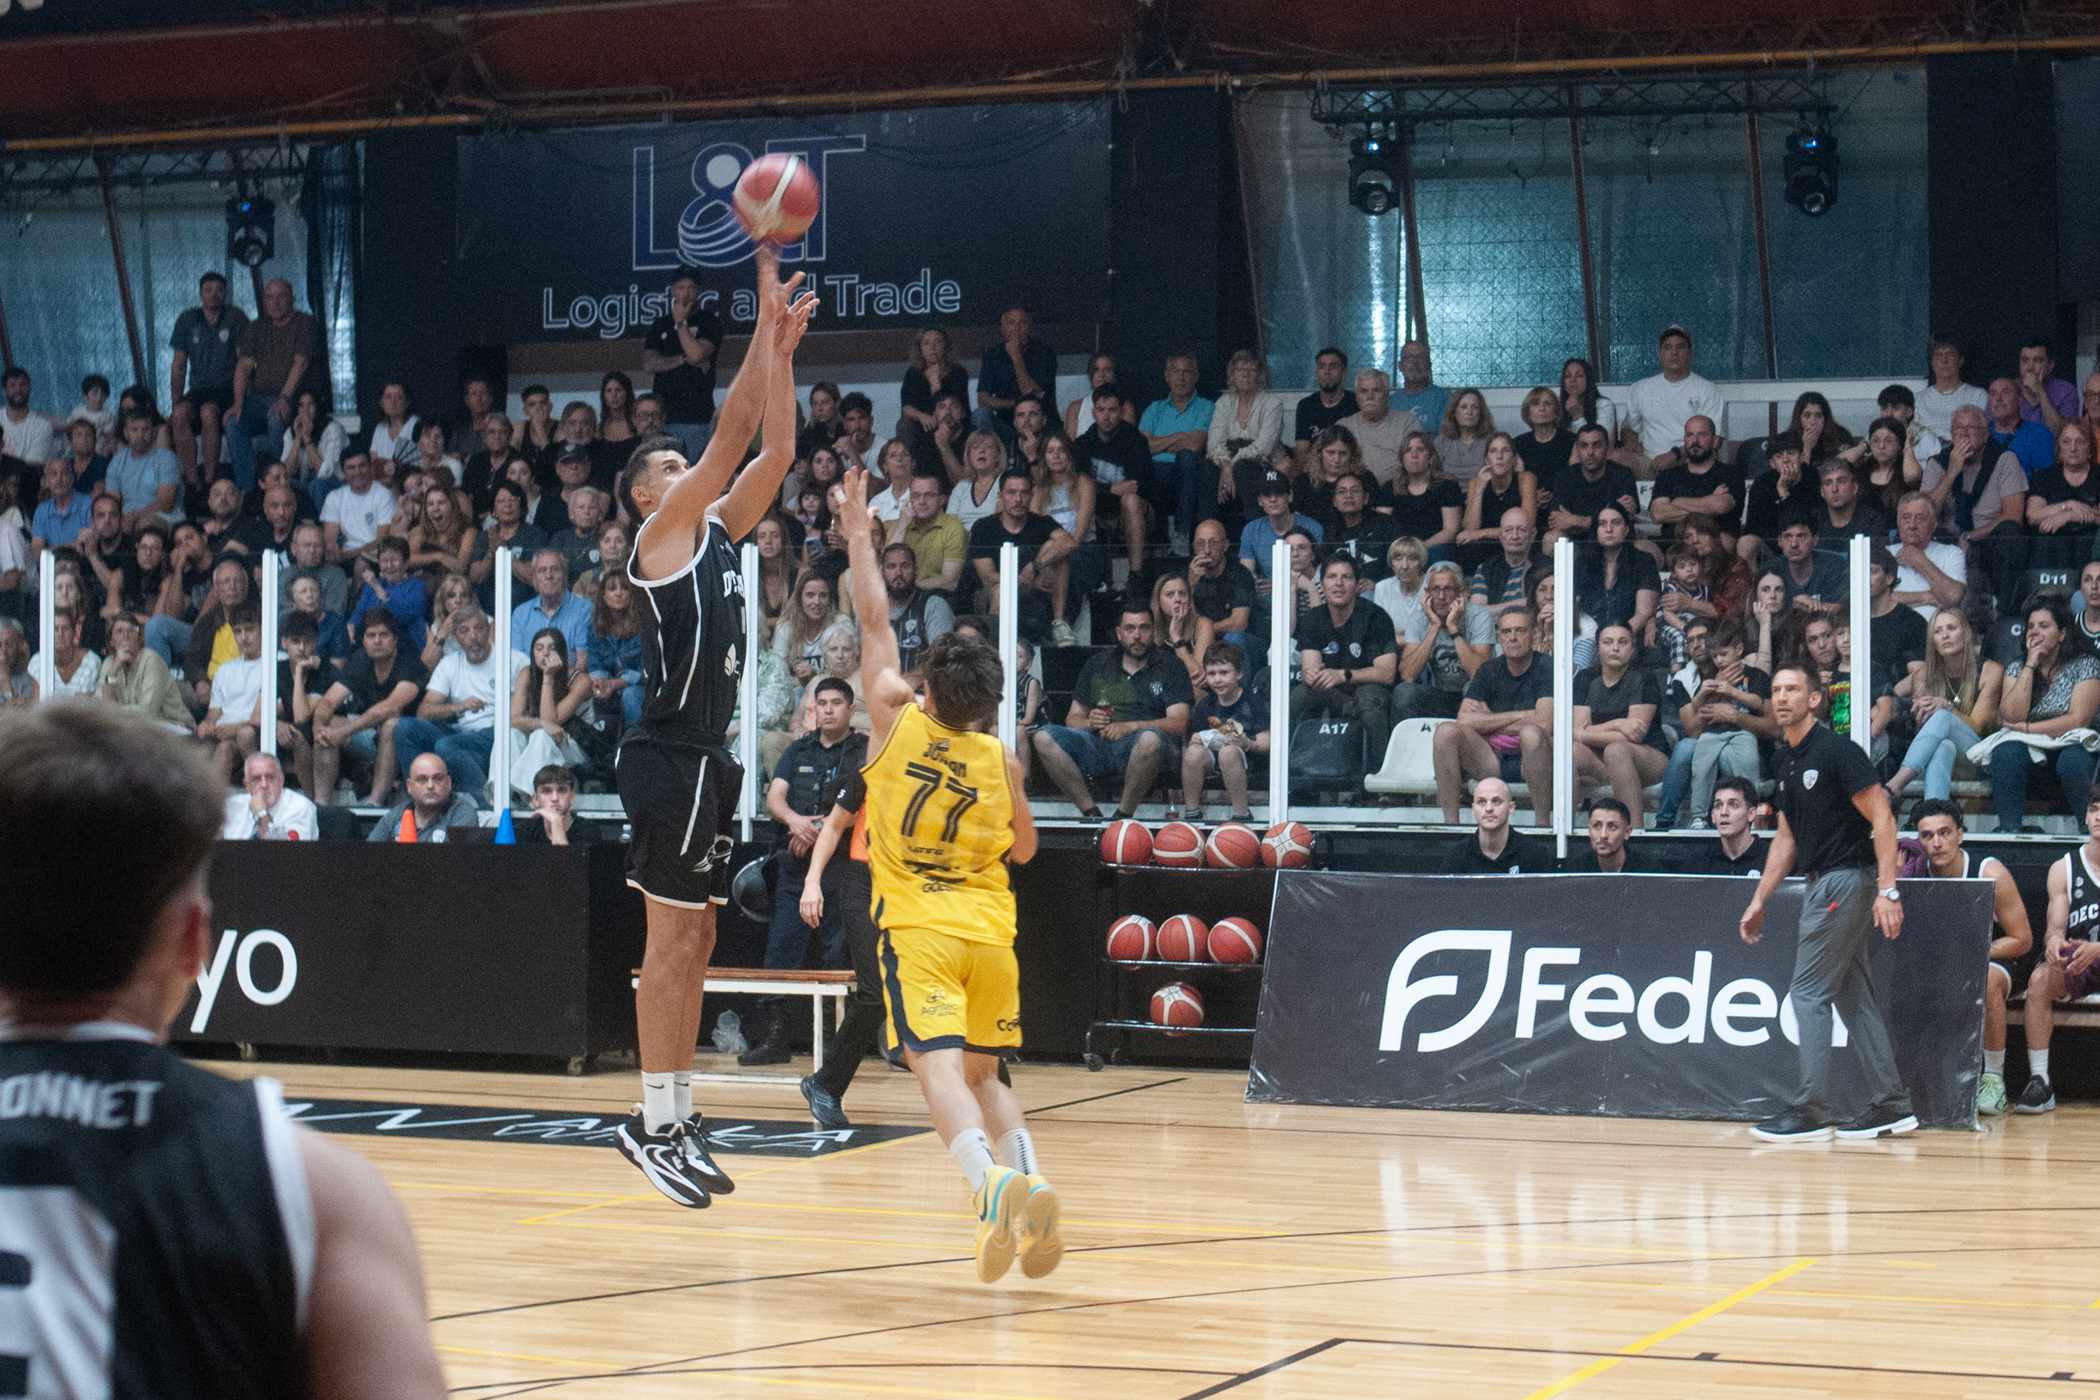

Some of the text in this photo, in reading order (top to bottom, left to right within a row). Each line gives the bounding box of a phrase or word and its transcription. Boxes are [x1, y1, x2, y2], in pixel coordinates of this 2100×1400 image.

[543, 268, 961, 339] Logistc ad Trade
[2039, 573, 2067, 585] D11
[1318, 722, 1349, 735] A17
[901, 761, 978, 843] 77
